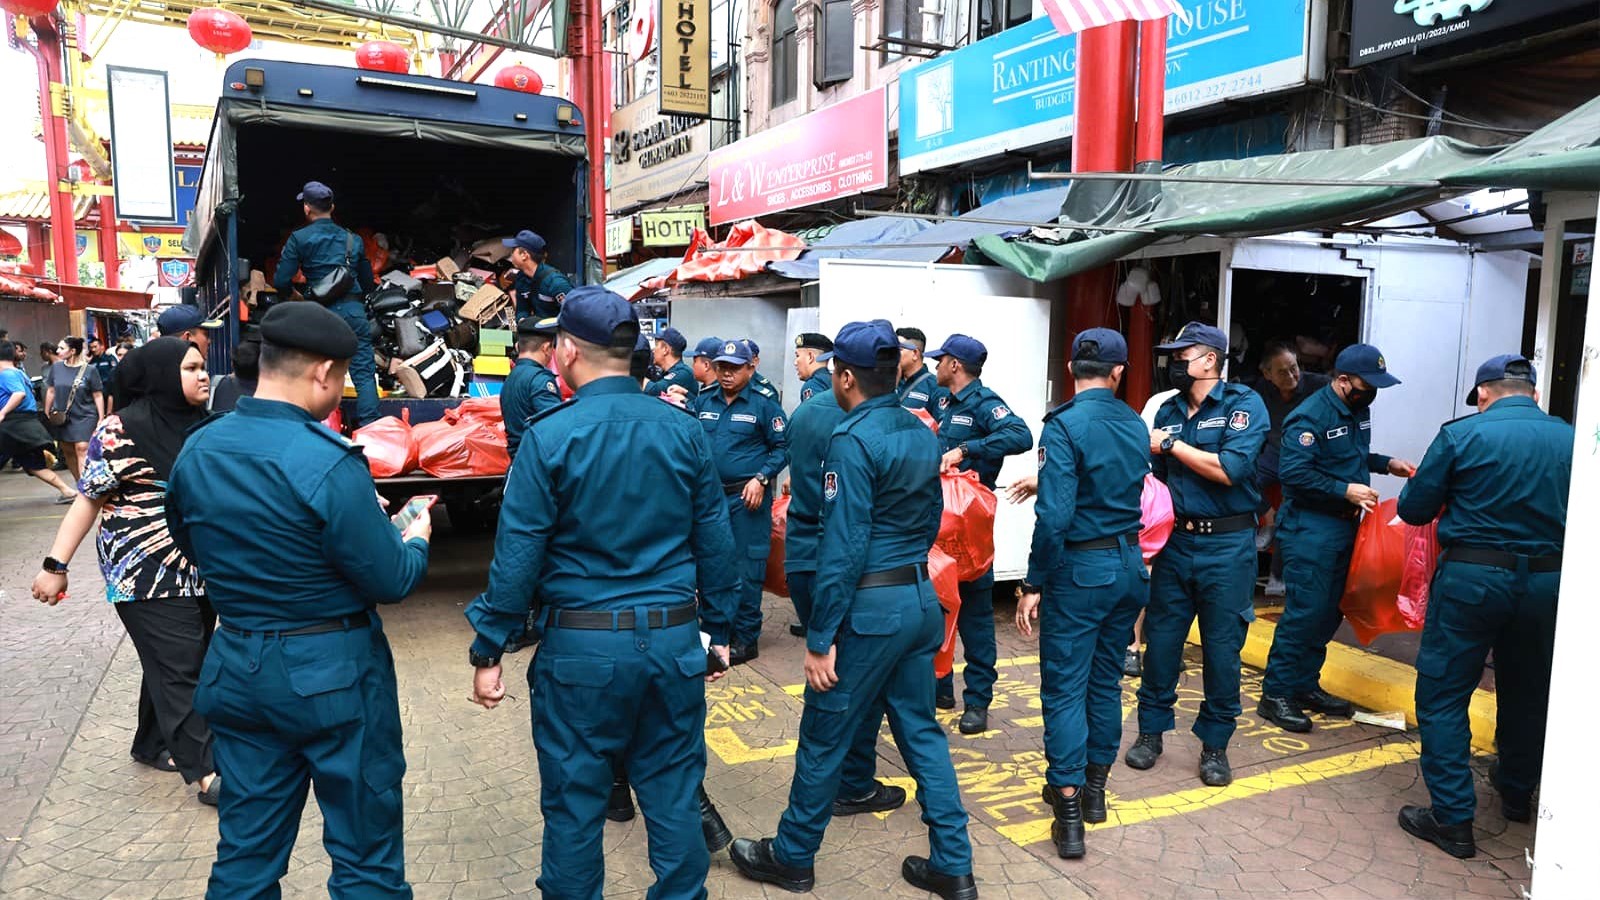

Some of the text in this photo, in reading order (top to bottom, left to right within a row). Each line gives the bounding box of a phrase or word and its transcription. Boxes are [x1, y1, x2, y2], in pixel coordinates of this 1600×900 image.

[676, 2, 696, 89] HOTEL
[992, 47, 1075, 94] RANTING
[1034, 91, 1073, 110] BUDGET
[766, 152, 836, 189] ENTERPRISE
[838, 169, 873, 188] CLOTHING
